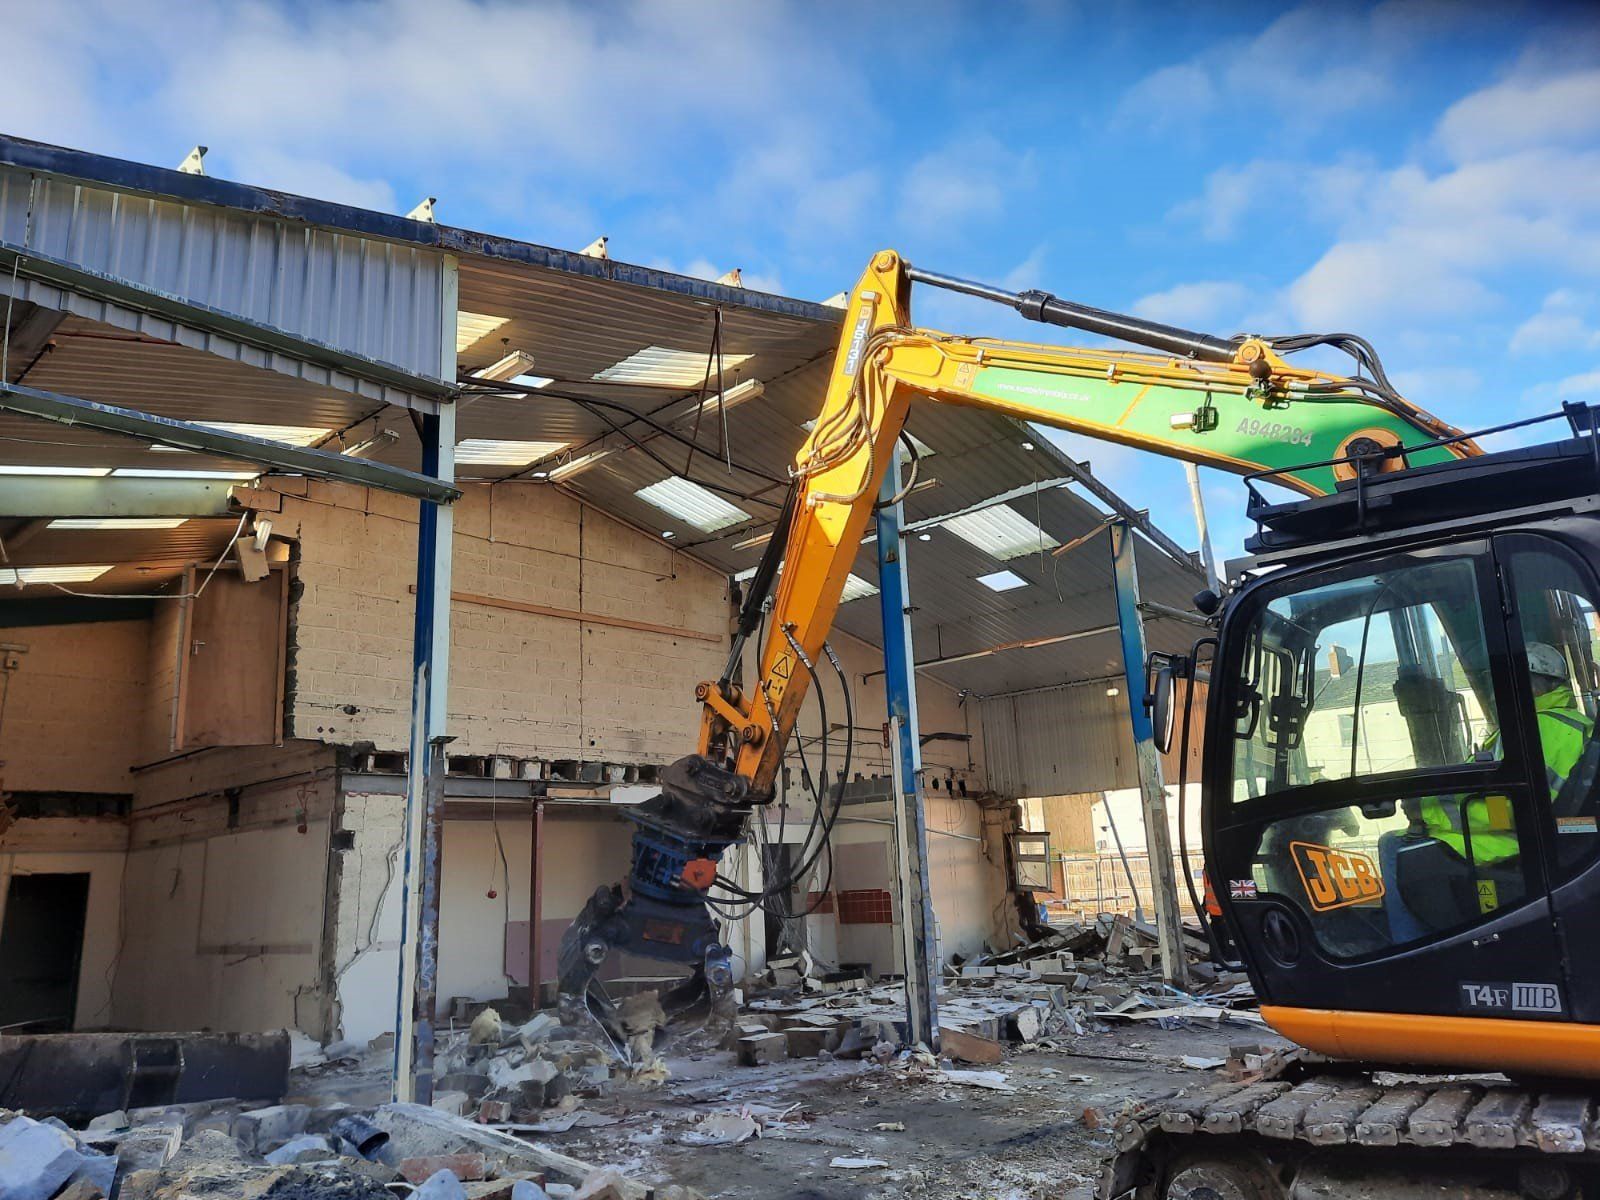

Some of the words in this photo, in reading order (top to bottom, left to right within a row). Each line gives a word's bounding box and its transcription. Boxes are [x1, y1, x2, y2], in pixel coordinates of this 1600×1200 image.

[1305, 849, 1378, 903] JCB
[1462, 985, 1508, 1007] T4F
[1517, 986, 1557, 1009] IIIB
